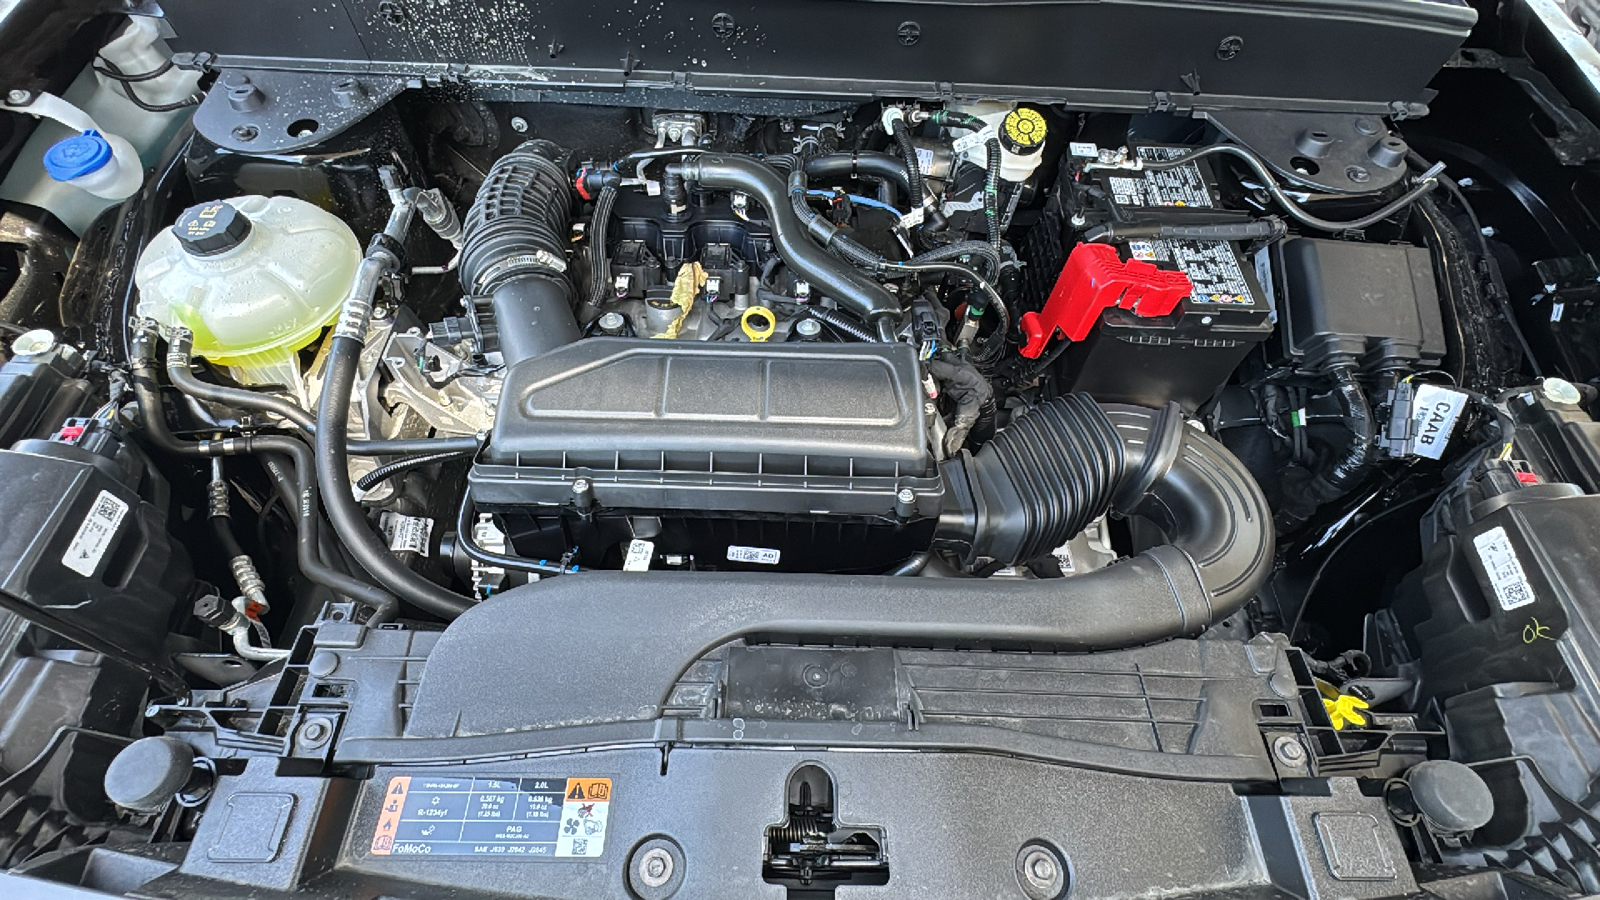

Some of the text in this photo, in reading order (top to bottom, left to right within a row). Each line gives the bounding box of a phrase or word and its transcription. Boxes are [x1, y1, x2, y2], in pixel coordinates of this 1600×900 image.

[1420, 402, 1451, 445] CAAB
[534, 781, 549, 789] 2.0L
[418, 808, 449, 818] R-1234yf
[506, 825, 523, 833] PAG
[391, 843, 432, 854] FoMoCo
